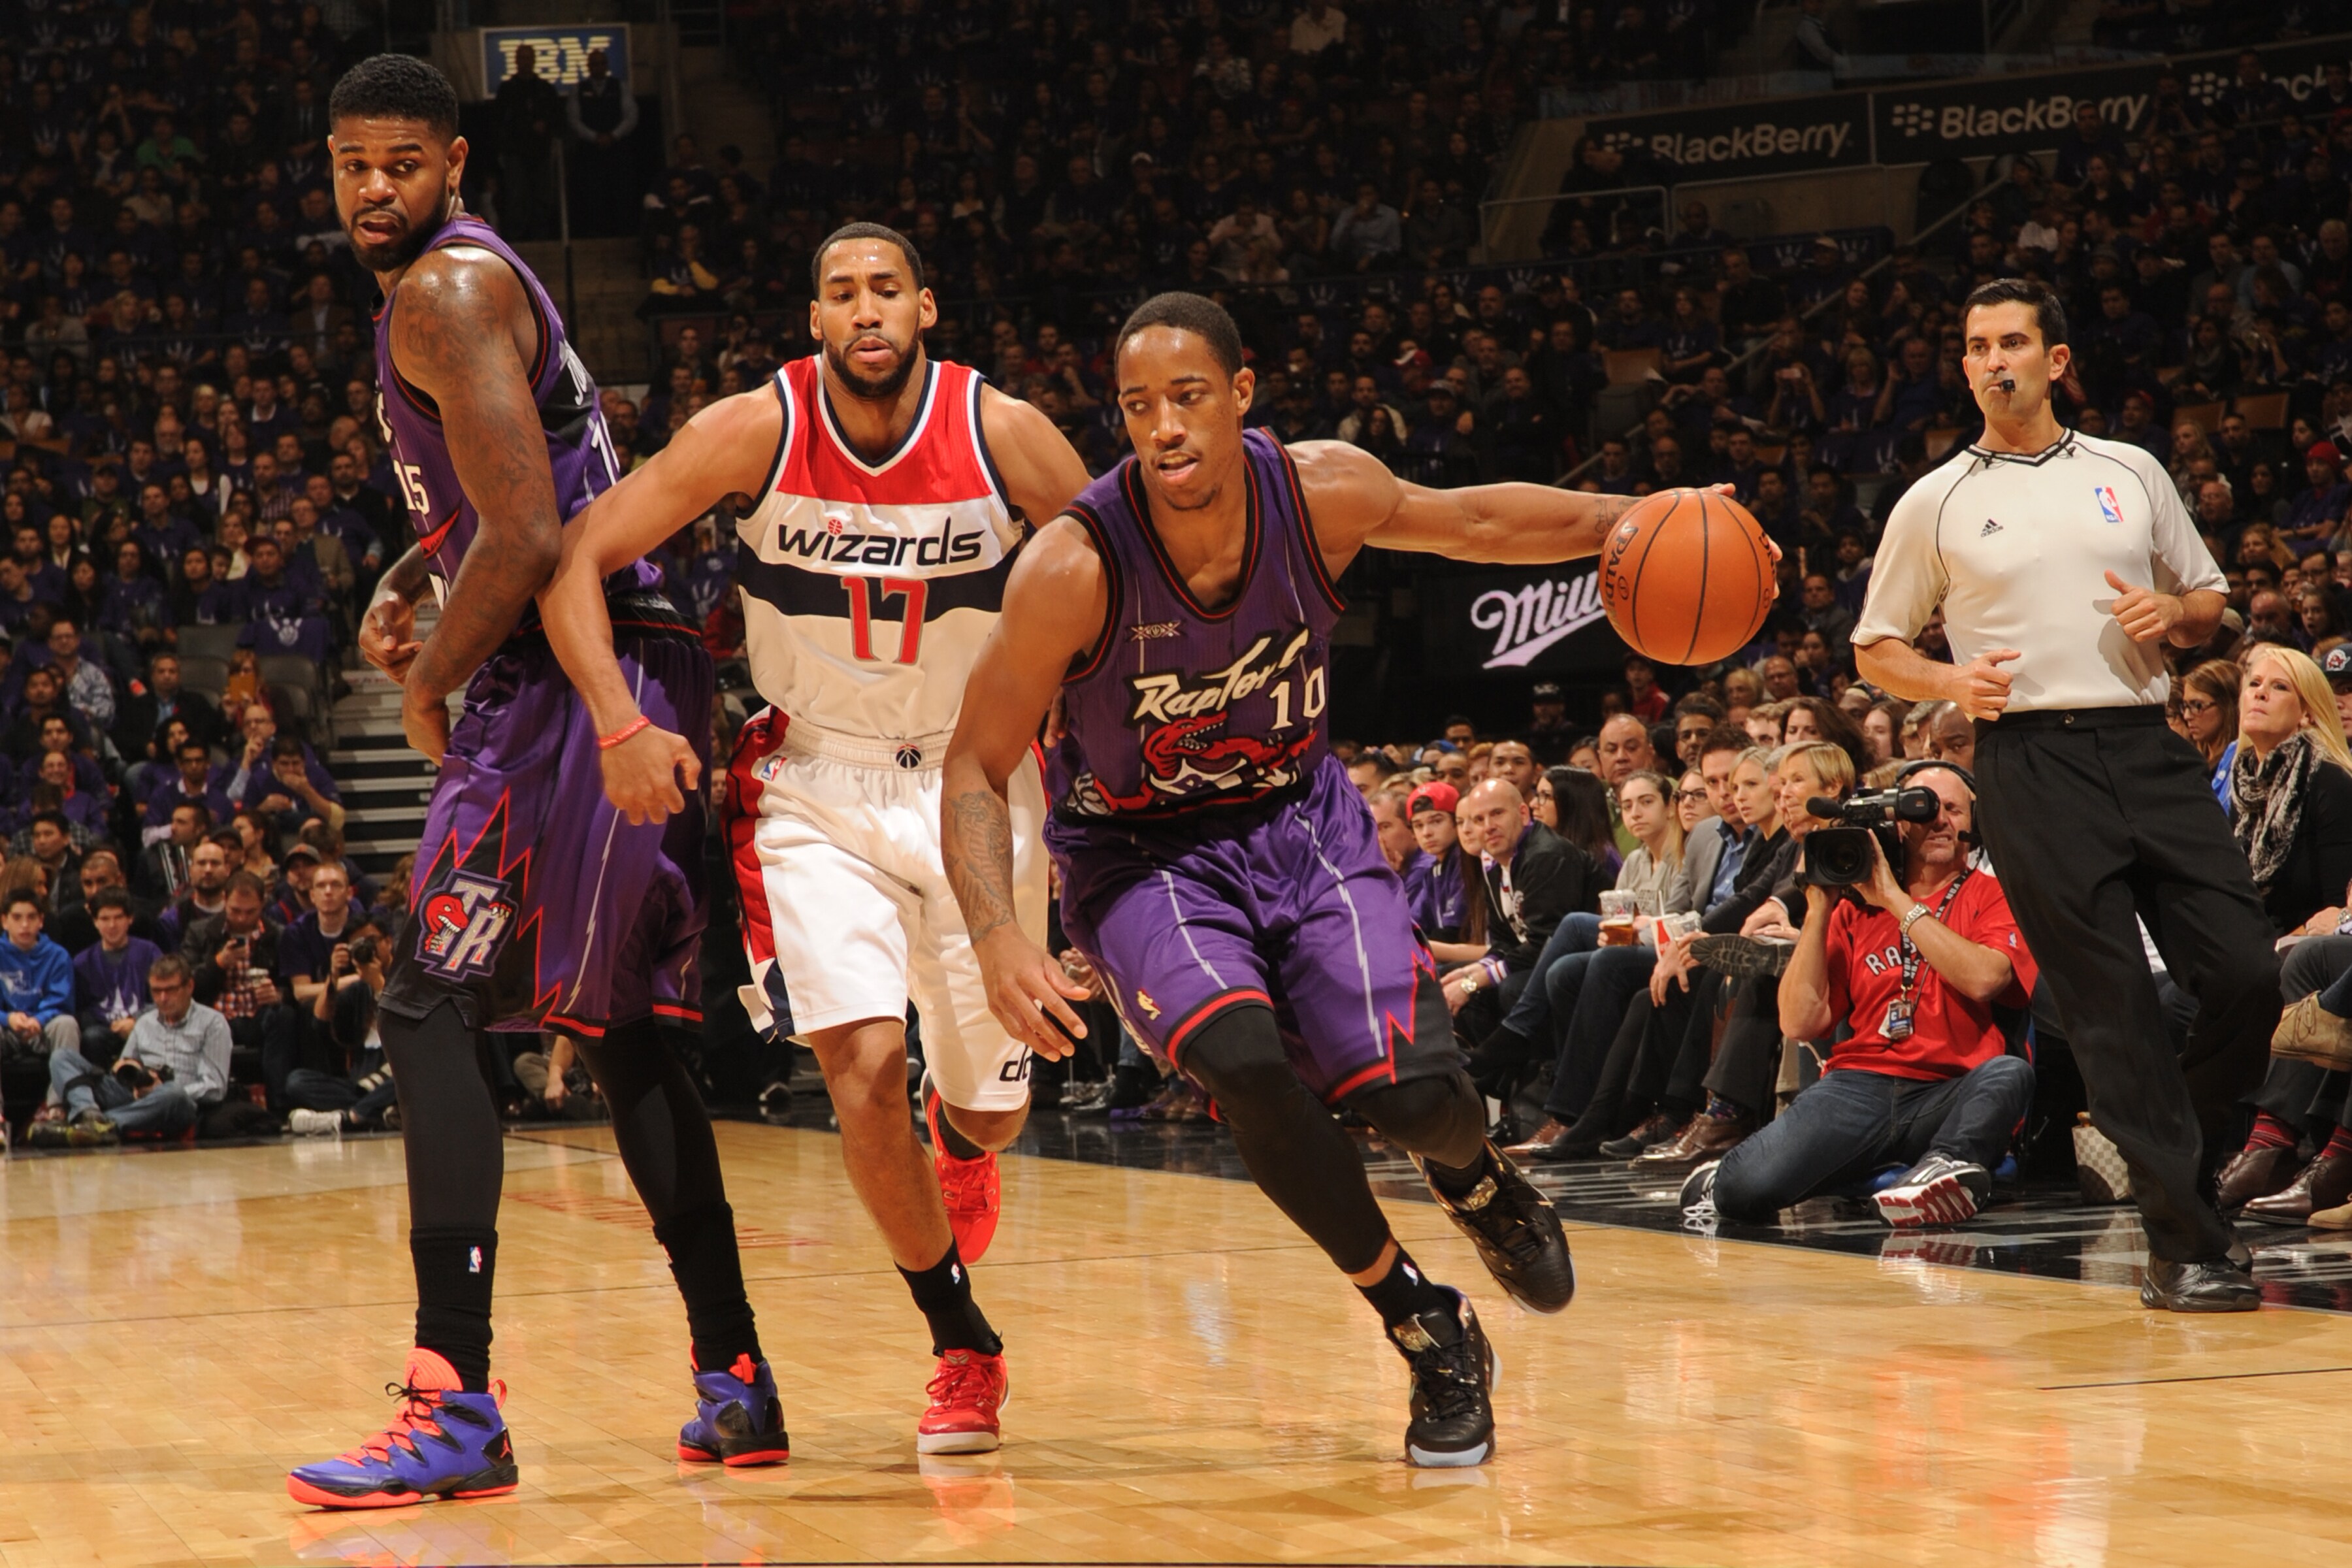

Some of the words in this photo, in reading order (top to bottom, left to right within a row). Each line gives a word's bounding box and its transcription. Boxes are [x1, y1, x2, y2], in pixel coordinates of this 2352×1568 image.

[498, 35, 612, 84] IBM
[1650, 122, 1851, 164] BlackBerry
[393, 459, 430, 515] 15
[778, 516, 985, 566] wizards
[840, 576, 928, 666] 17
[1471, 570, 1606, 655] Mill
[1269, 666, 1326, 730] 10
